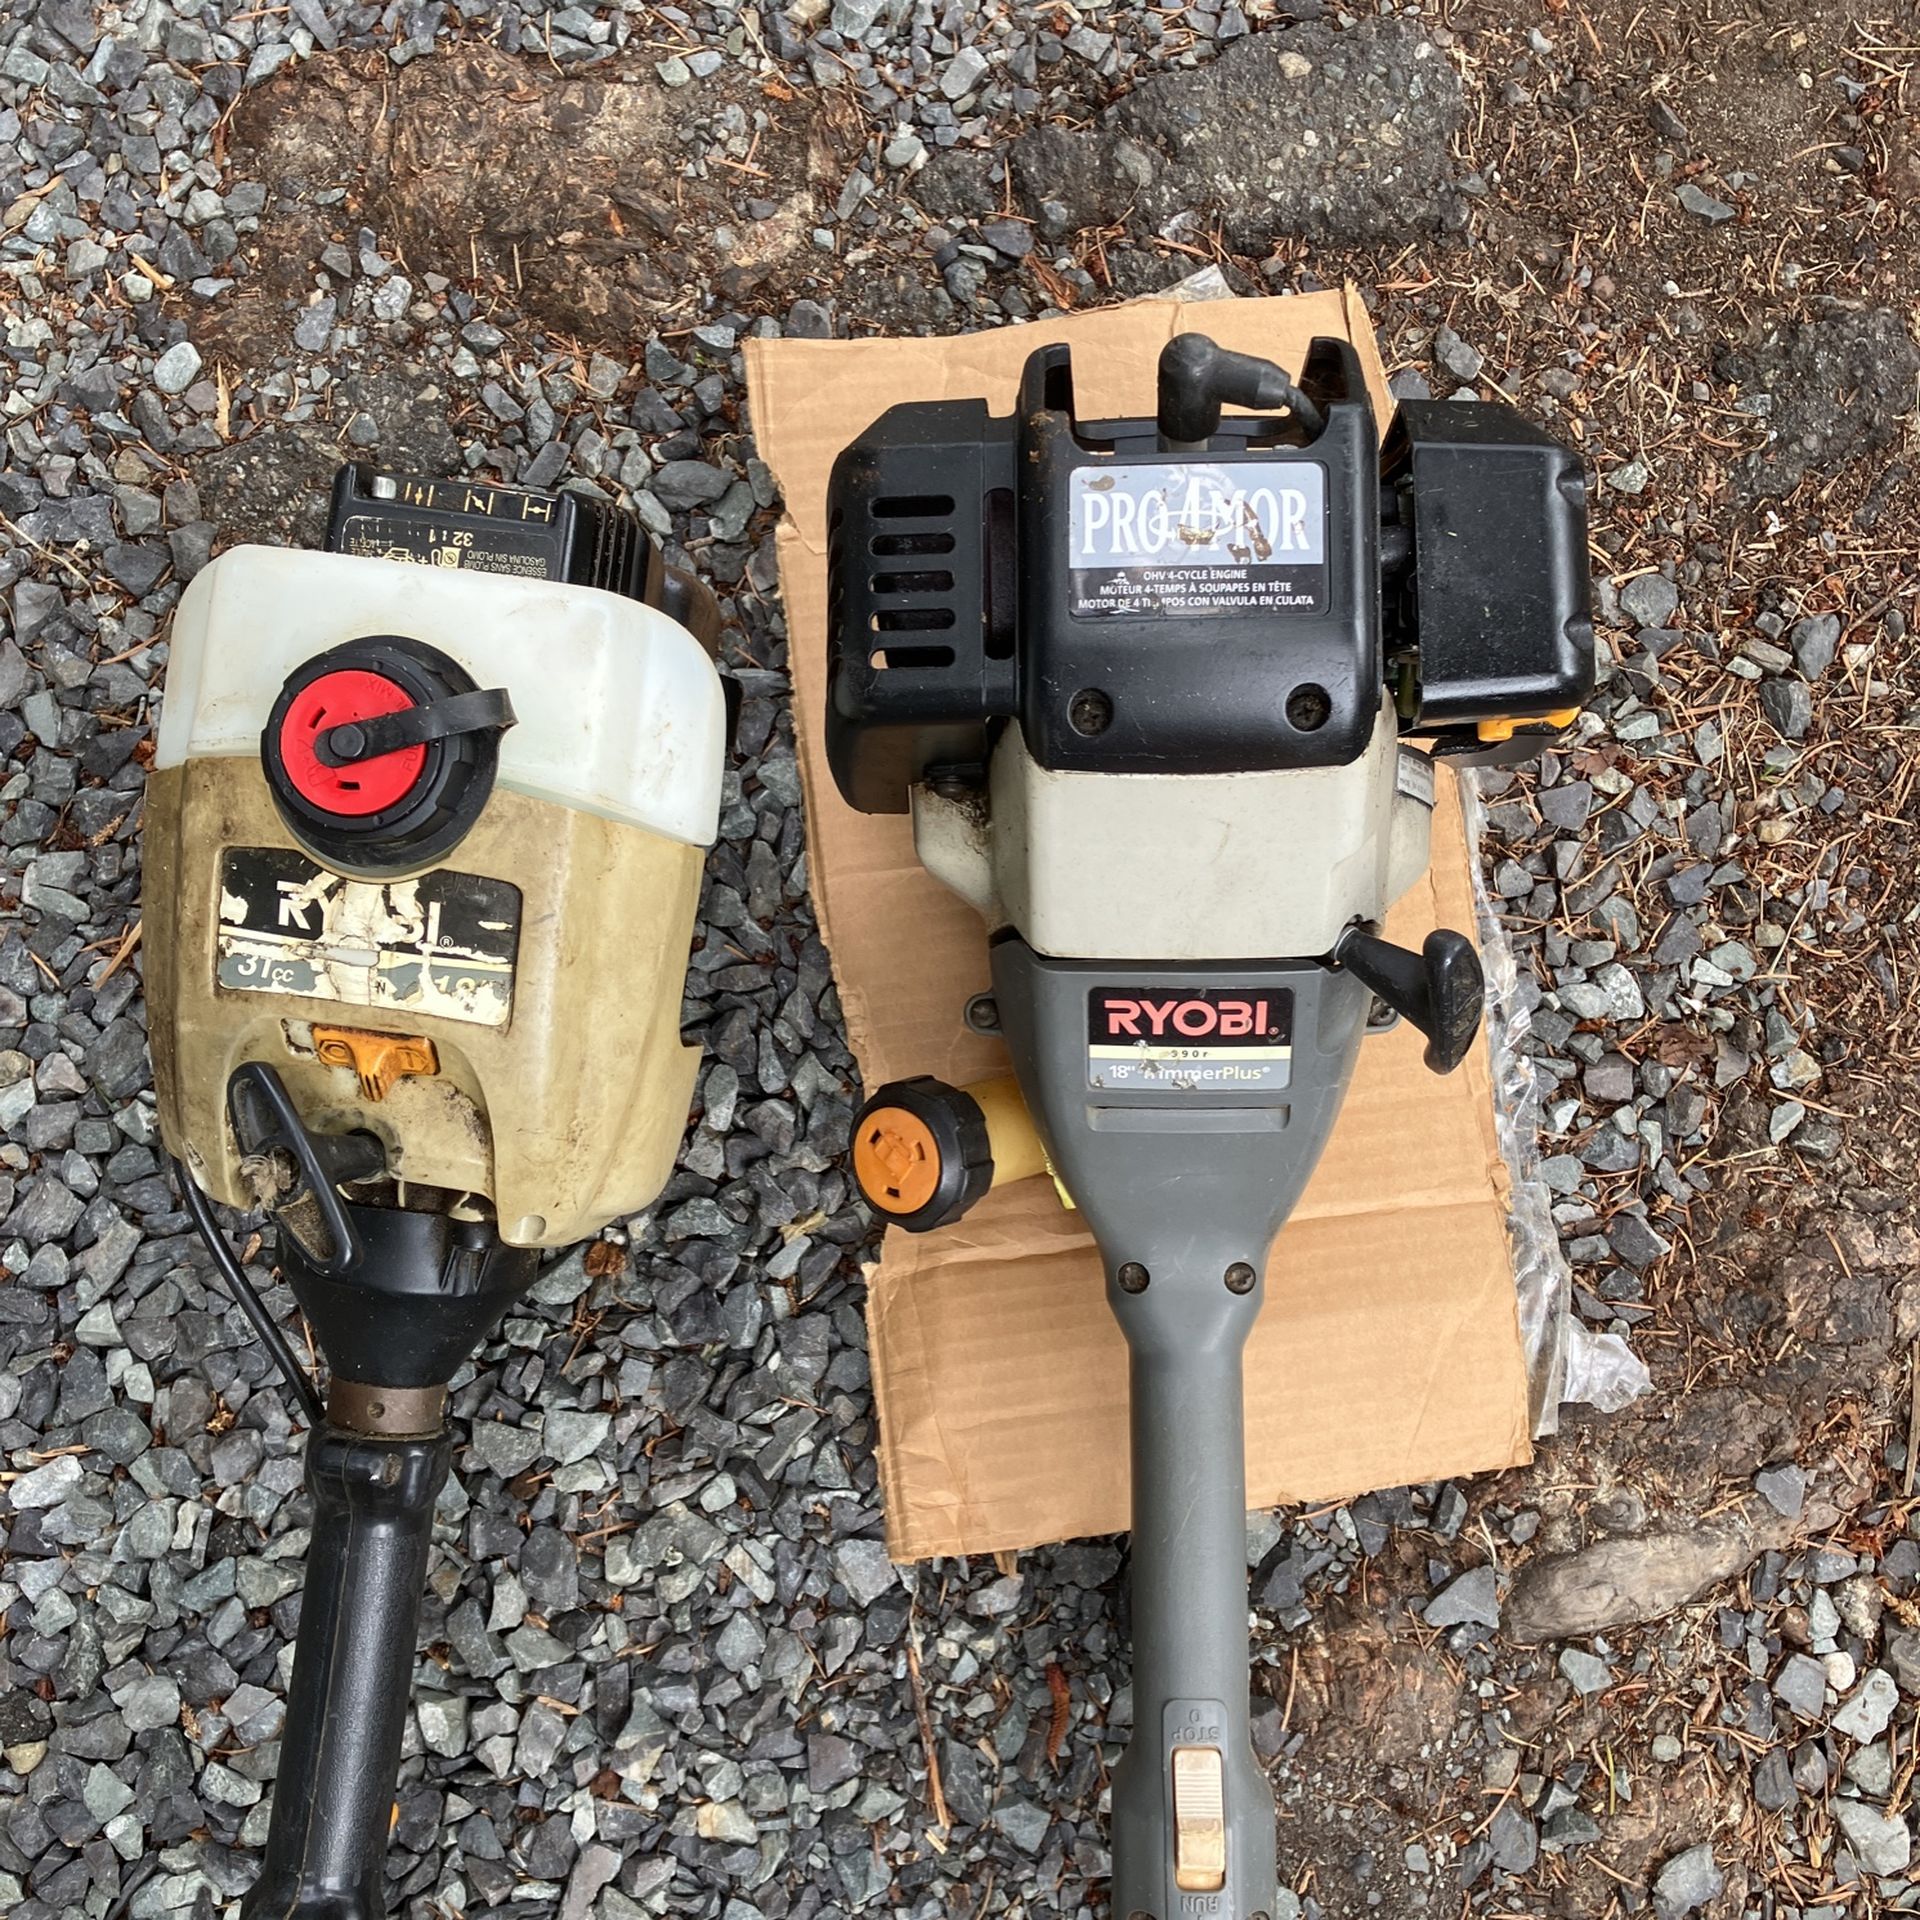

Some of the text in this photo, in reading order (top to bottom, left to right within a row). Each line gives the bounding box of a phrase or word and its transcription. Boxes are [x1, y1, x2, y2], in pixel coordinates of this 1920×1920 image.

[467, 550, 546, 567] GASOLINA SIN PLOMO
[464, 559, 547, 577] ESSENCE SANS PLOMB
[1143, 569, 1247, 581] OHV 4-CYCLE ENGINE
[1100, 580, 1292, 595] MOTEUR 4-TEMPS À SOUPAPES EN TÊTE
[1078, 599, 1116, 609] MOTOR
[1118, 598, 1131, 608] DE
[1133, 597, 1140, 608] 4
[1188, 596, 1210, 606] CON
[1212, 596, 1257, 606] VALVULA
[1260, 595, 1273, 606] EN
[1275, 595, 1314, 606] CULATA
[1171, 1726, 1221, 1742] STOP
[1181, 1896, 1219, 1913] RUN
